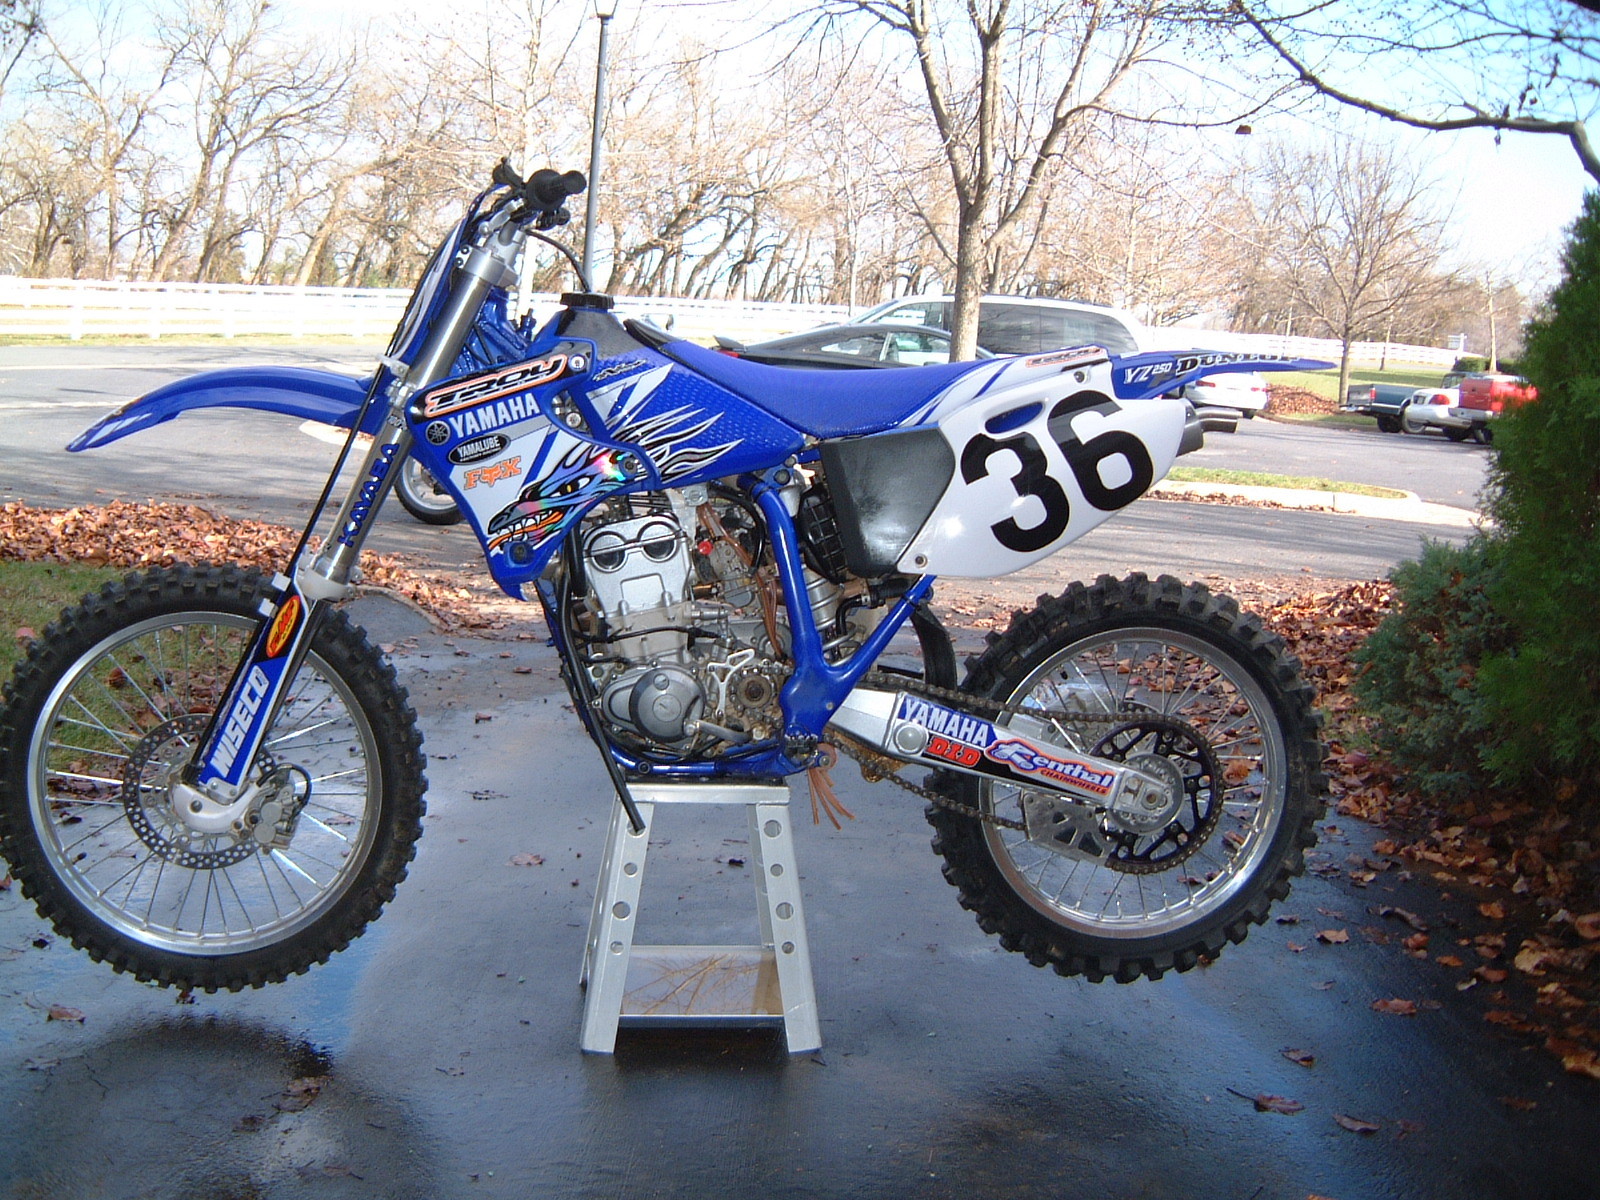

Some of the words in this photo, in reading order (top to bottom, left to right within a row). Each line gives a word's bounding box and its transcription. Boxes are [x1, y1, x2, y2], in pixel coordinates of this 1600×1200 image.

[449, 393, 540, 438] YAMAHA
[457, 435, 501, 458] YAMALUBE
[463, 455, 522, 490] FOX
[960, 390, 1153, 552] 36
[210, 665, 270, 778] WISECO
[902, 695, 990, 747] YAMAHA
[987, 741, 1117, 788] Renthal
[1040, 768, 1108, 796] CHAINWHEELS
